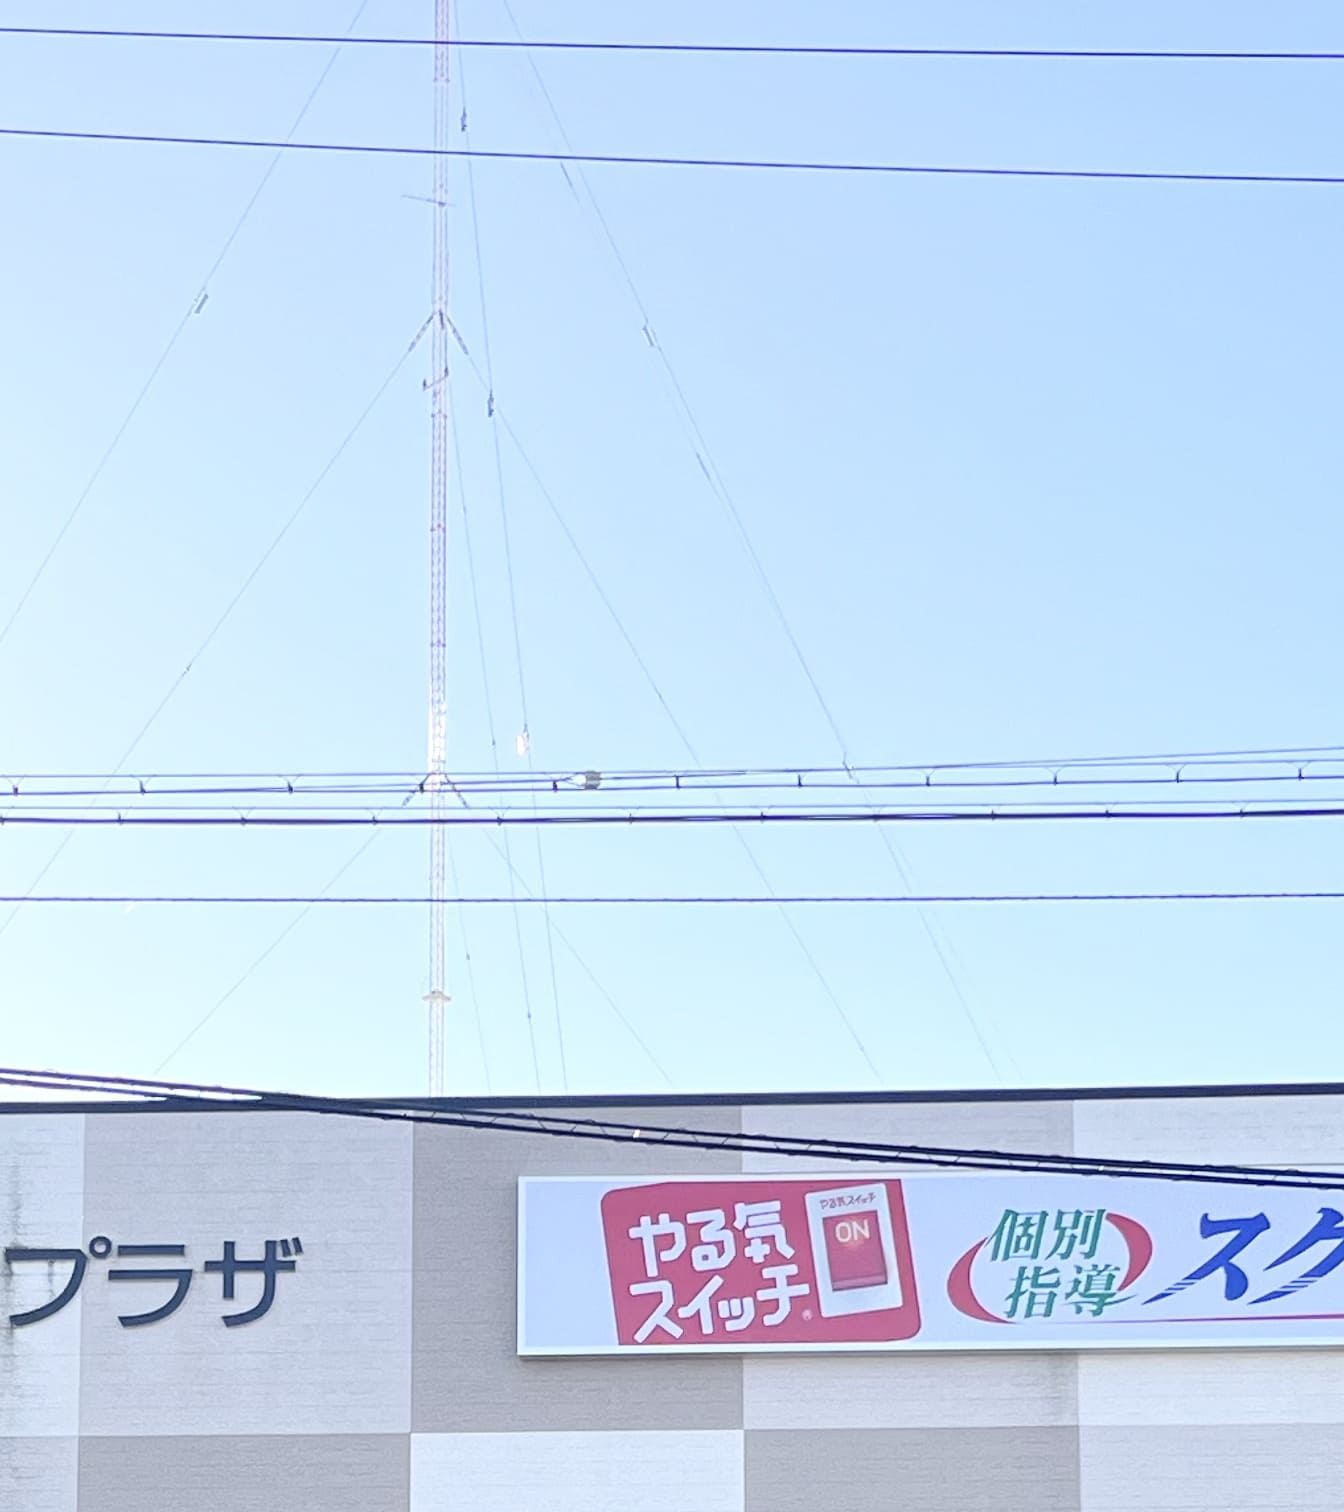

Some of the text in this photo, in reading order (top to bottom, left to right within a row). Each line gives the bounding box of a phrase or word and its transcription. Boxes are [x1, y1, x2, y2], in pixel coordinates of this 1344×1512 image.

[628, 1200, 795, 1278] やる気
[835, 1219, 870, 1243] ON
[989, 1208, 1106, 1263] 個別
[629, 1263, 810, 1344] スイッチ
[1004, 1264, 1124, 1320] 指導
